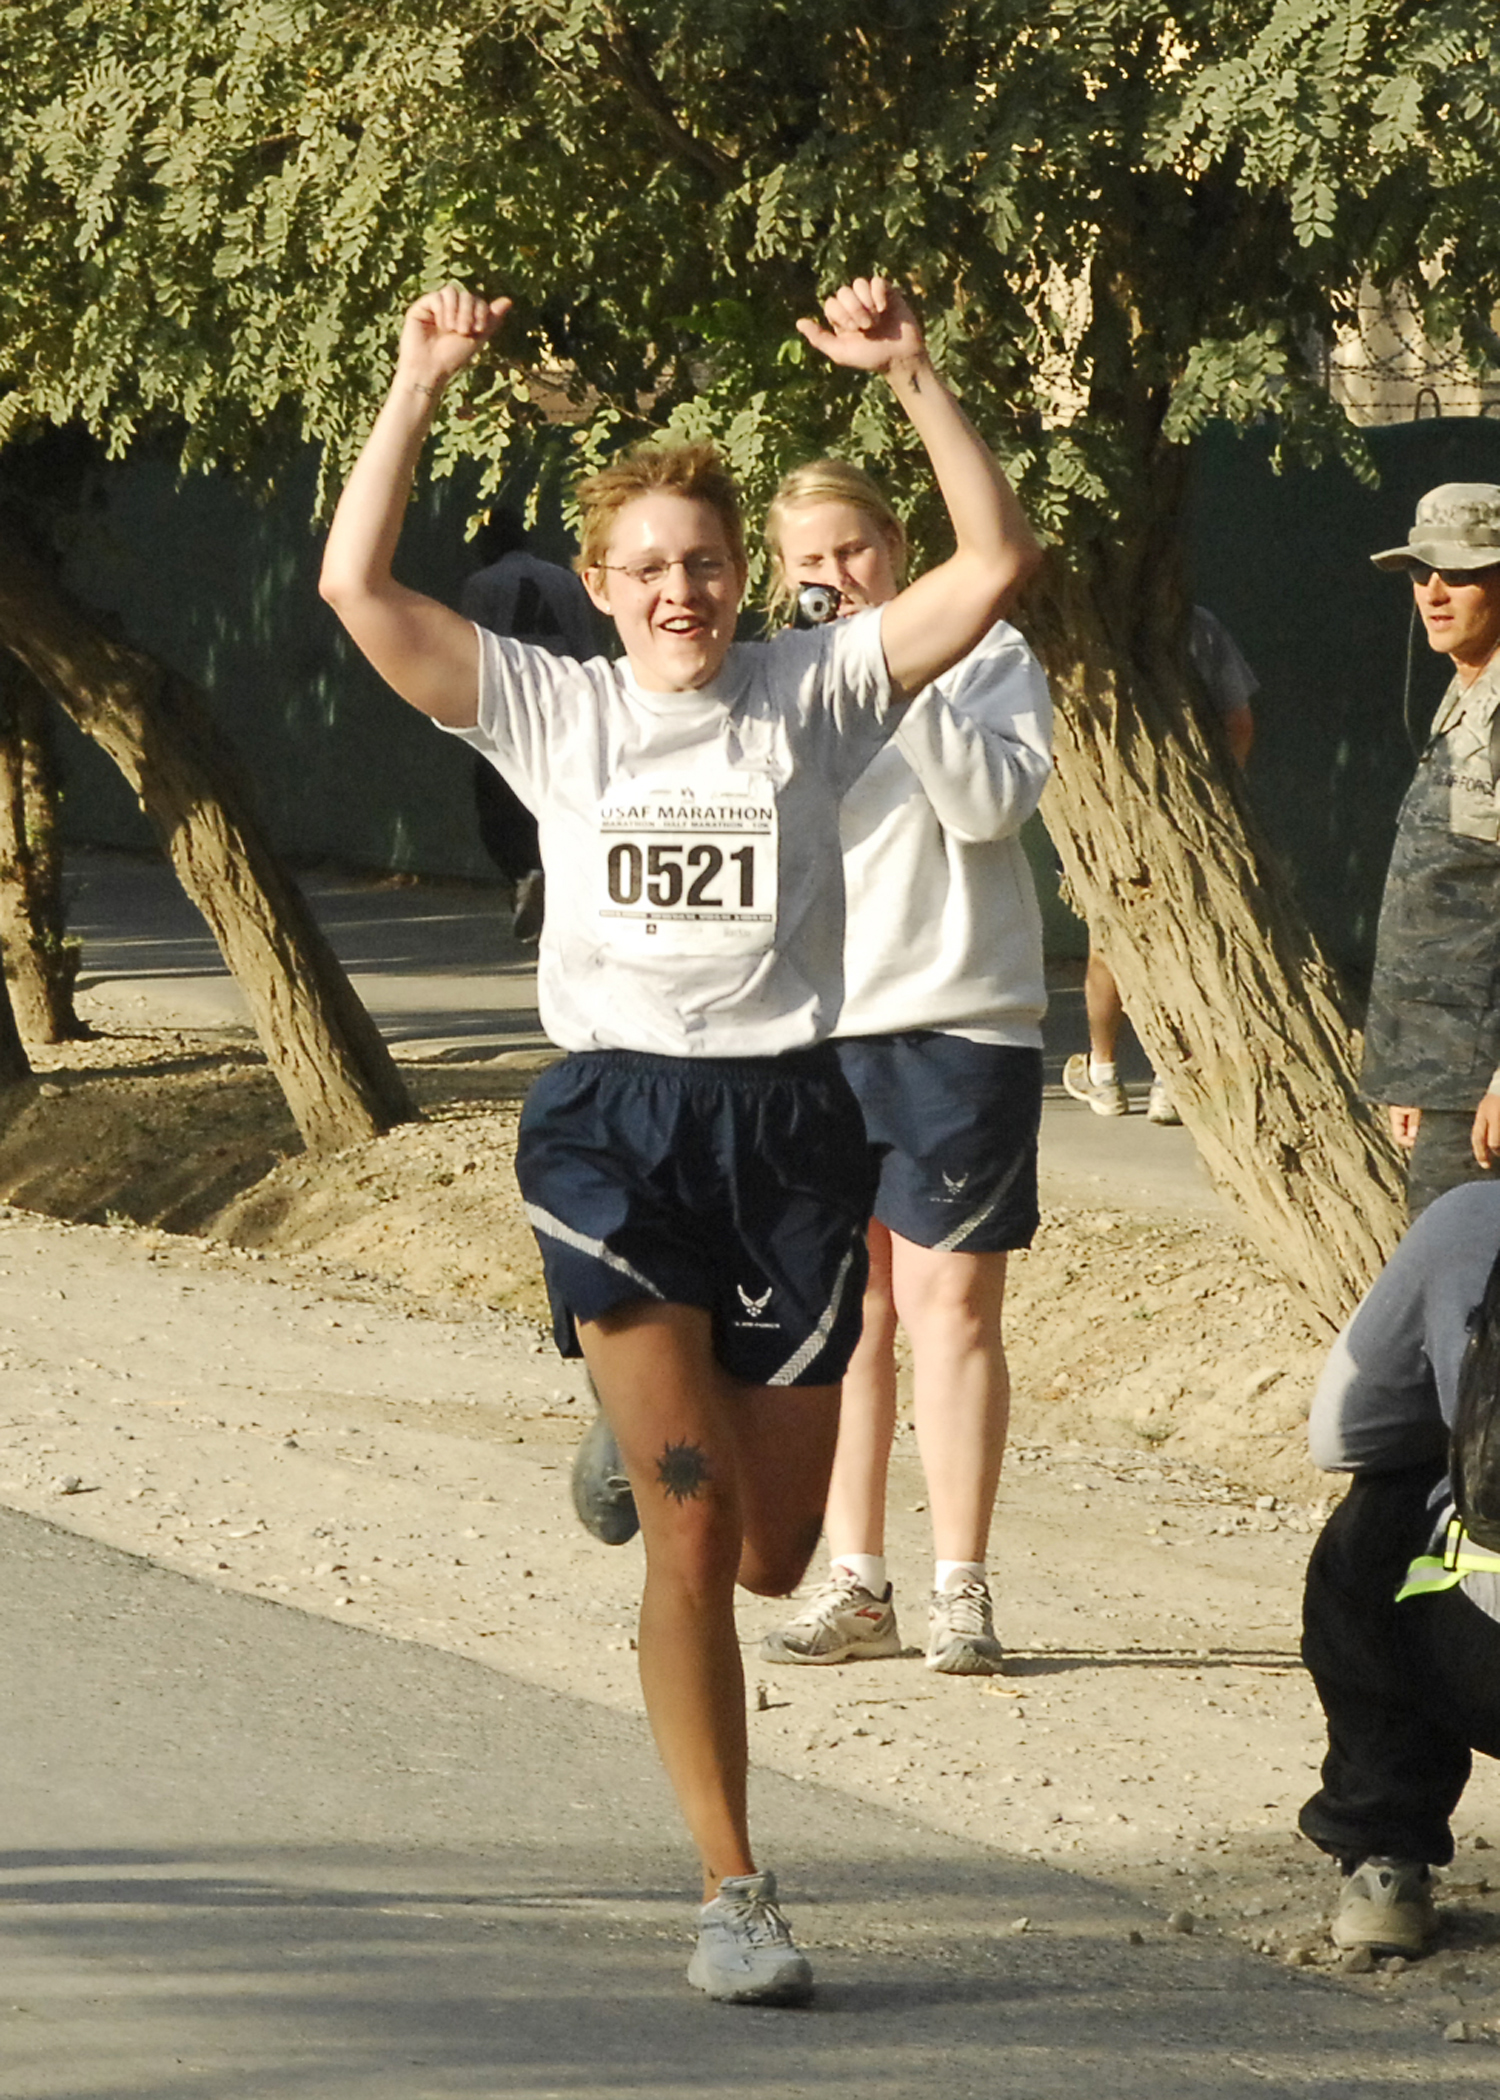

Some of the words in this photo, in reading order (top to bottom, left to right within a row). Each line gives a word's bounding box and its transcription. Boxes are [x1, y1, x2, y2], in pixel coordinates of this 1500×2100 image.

[600, 805, 651, 819] USAF
[657, 806, 773, 821] MARATHON
[601, 820, 655, 828] MARATHON
[663, 821, 687, 829] HALF
[690, 821, 743, 829] MARATHON
[607, 842, 755, 908] 0521
